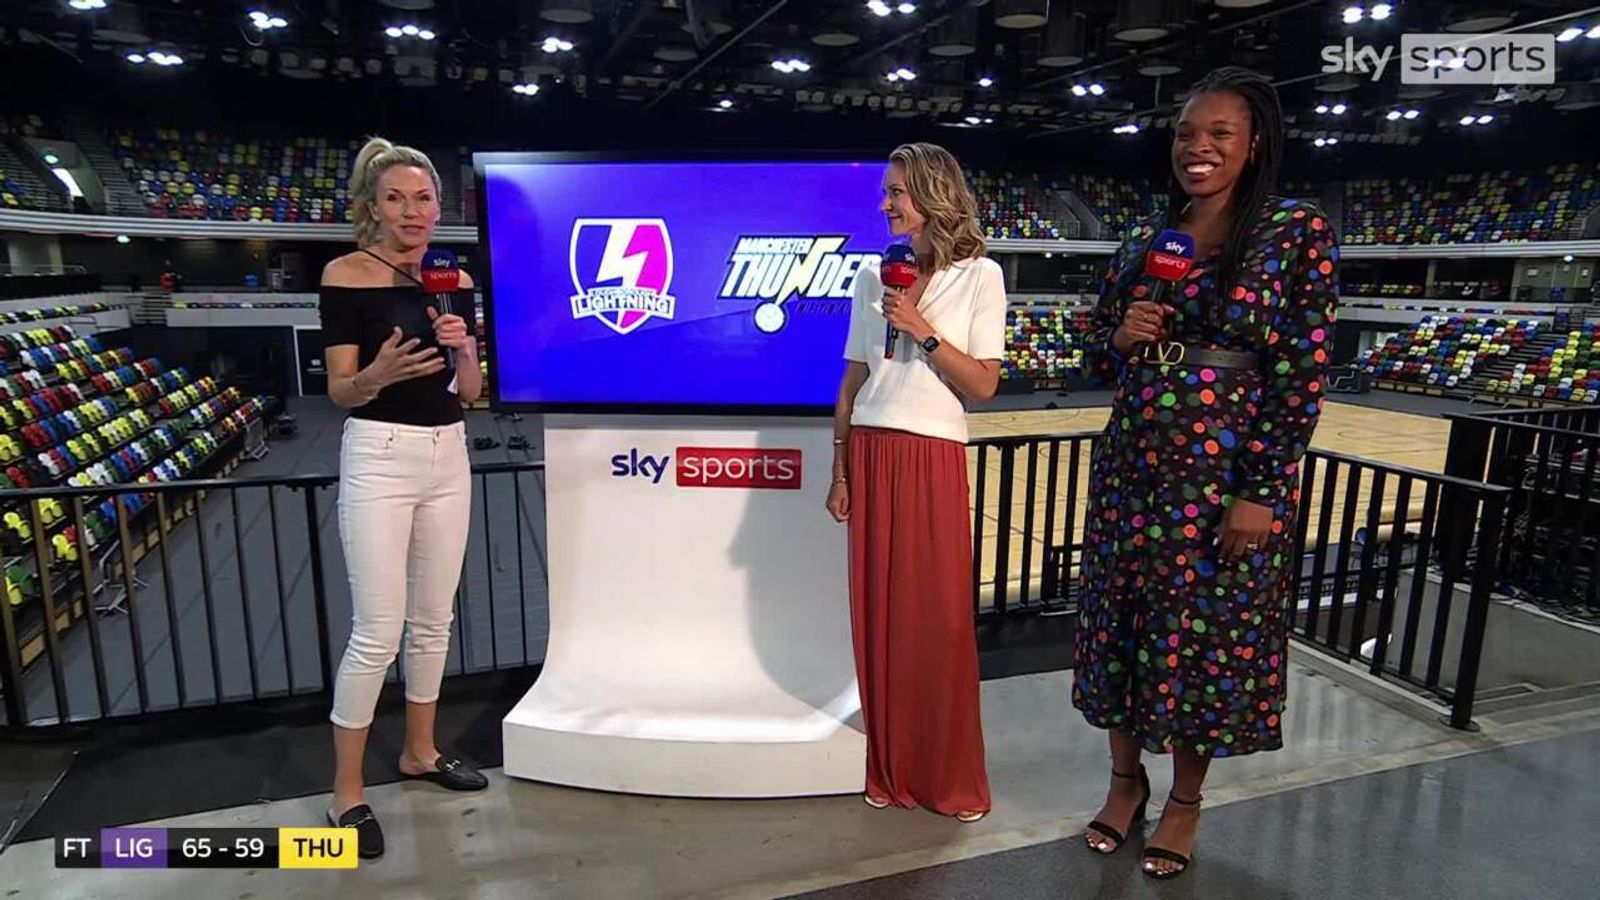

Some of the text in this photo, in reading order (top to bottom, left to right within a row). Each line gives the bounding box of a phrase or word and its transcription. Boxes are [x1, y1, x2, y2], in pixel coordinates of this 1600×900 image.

[1165, 241, 1186, 255] sky
[433, 258, 450, 268] sky
[576, 293, 671, 314] LIGHTNING
[611, 447, 794, 484] sky sports
